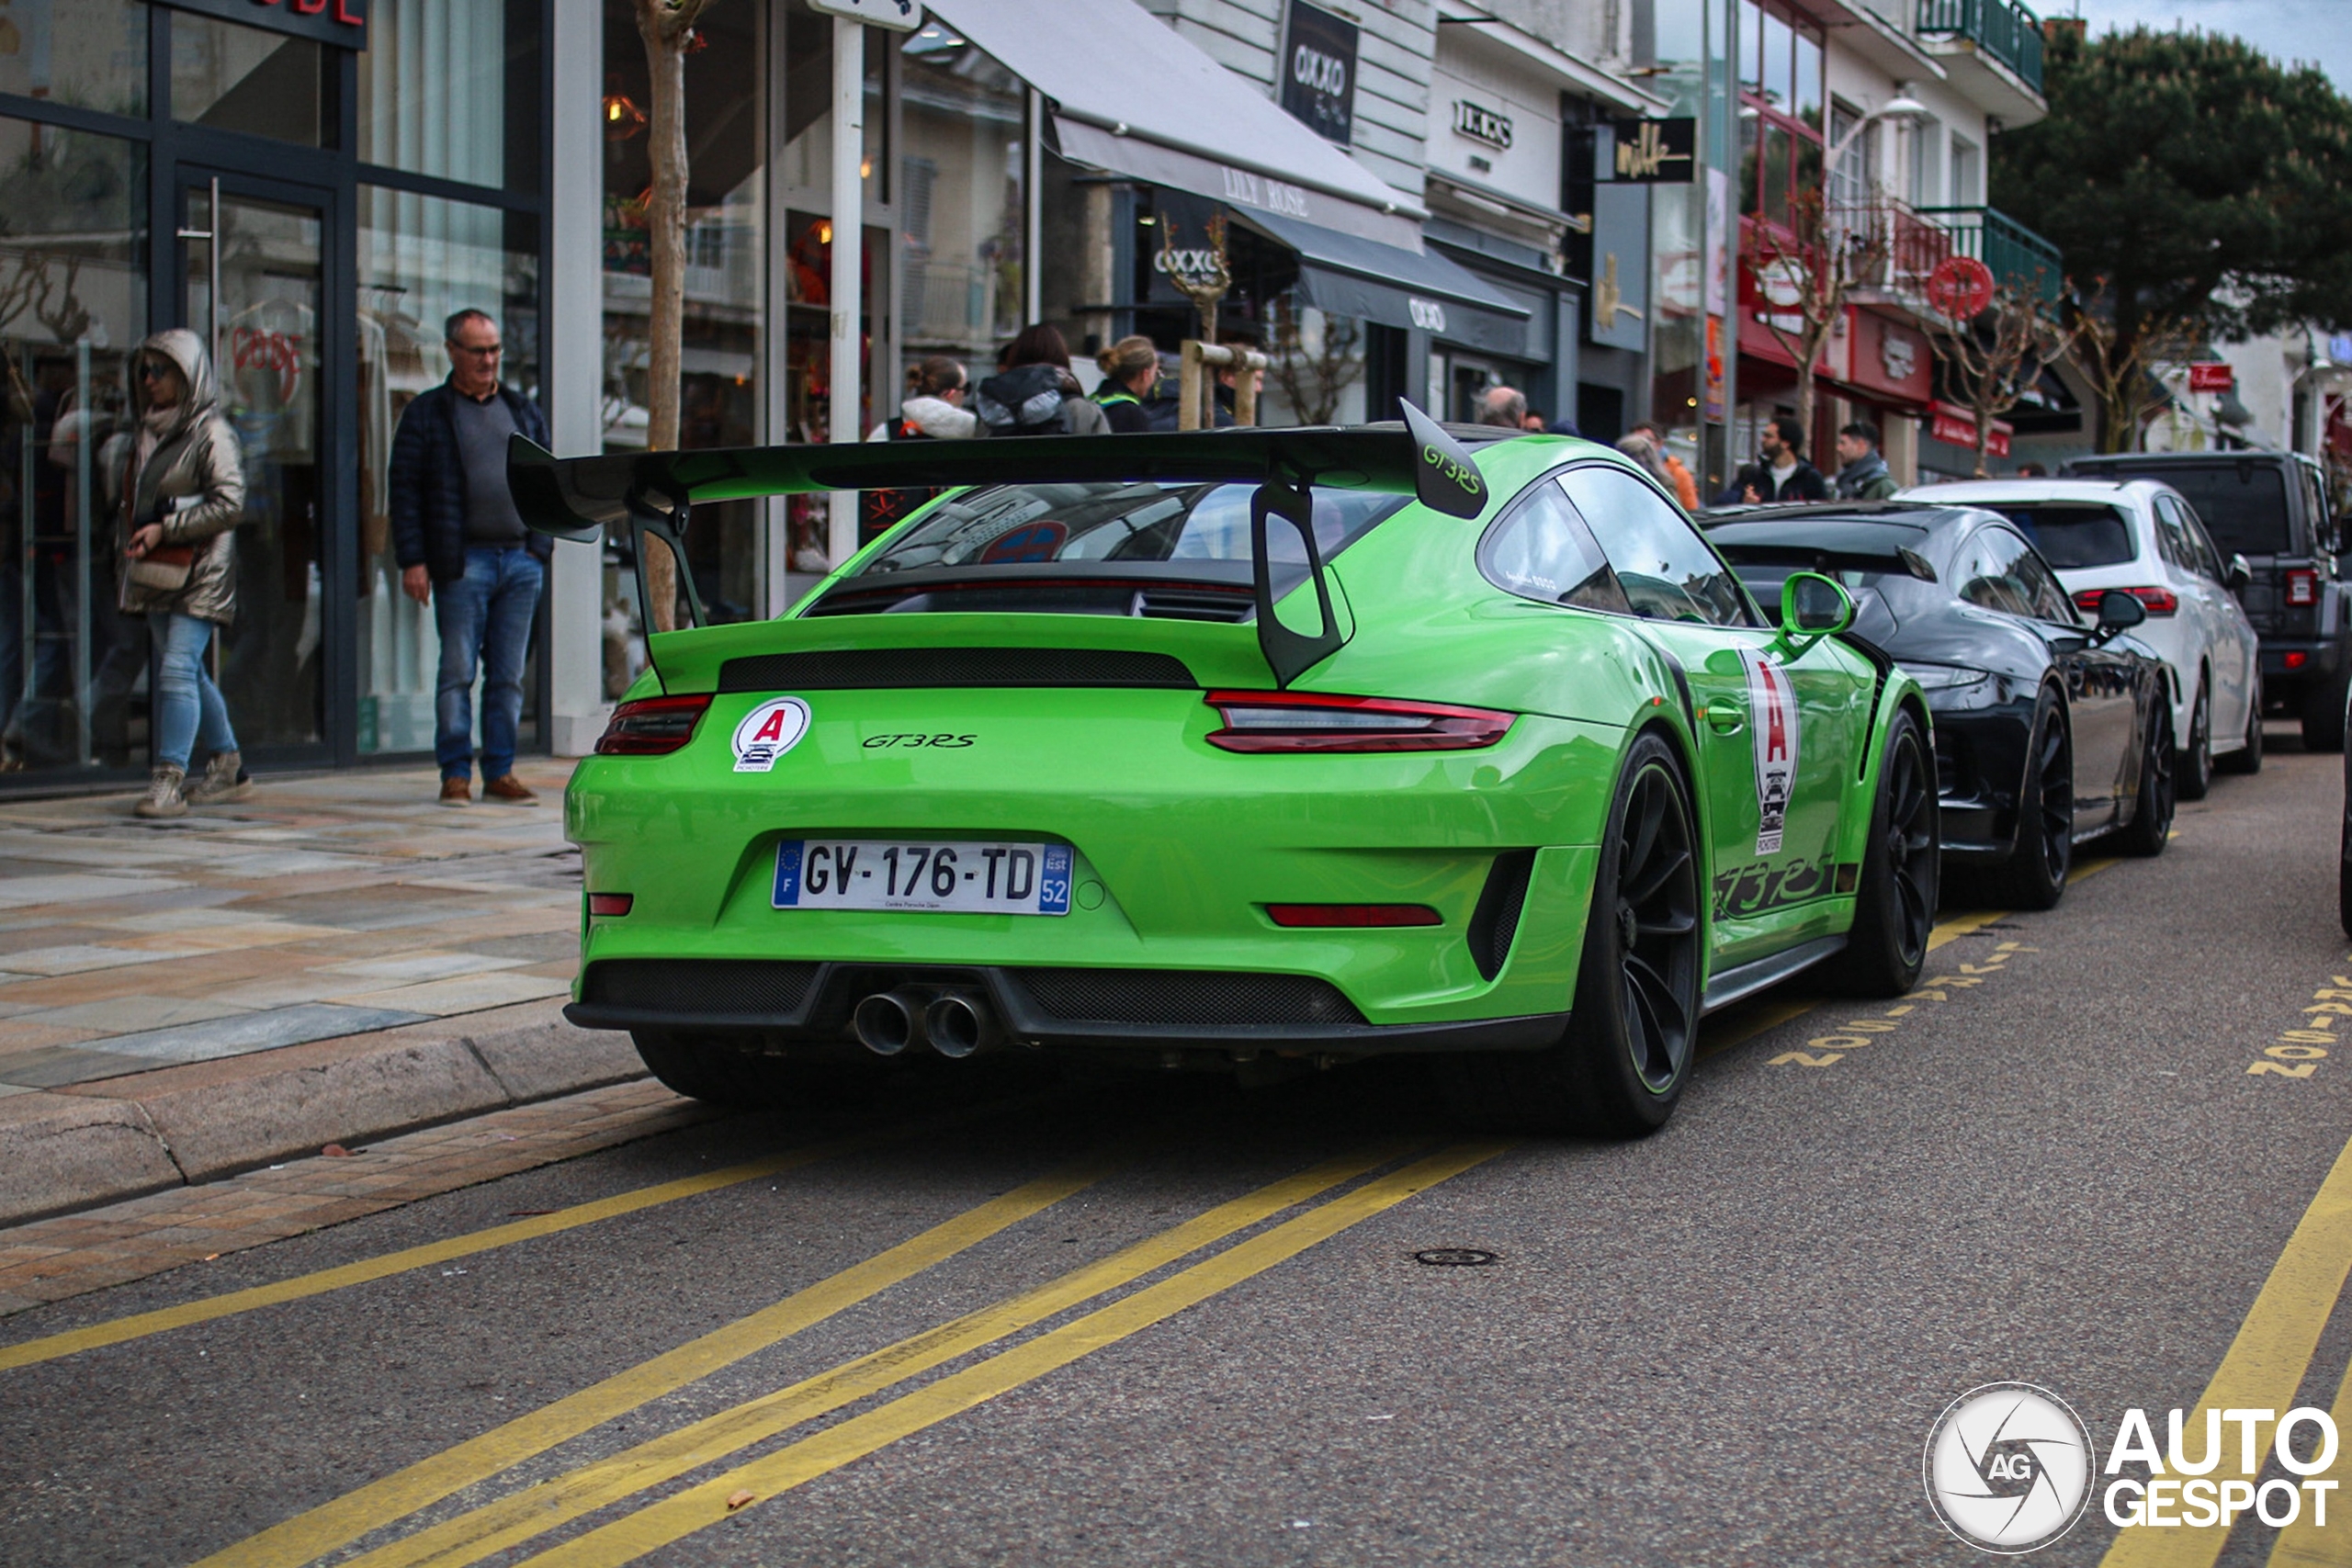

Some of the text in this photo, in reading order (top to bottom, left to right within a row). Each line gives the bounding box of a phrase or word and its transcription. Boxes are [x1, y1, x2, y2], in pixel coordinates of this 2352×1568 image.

[1222, 165, 1308, 218] LILY ROSE
[752, 708, 786, 742] A
[1757, 660, 1787, 763] A
[806, 845, 1035, 900] GV-176-TD
[1046, 858, 1068, 871] Est
[783, 878, 793, 893] F
[1041, 879, 1068, 904] 52
